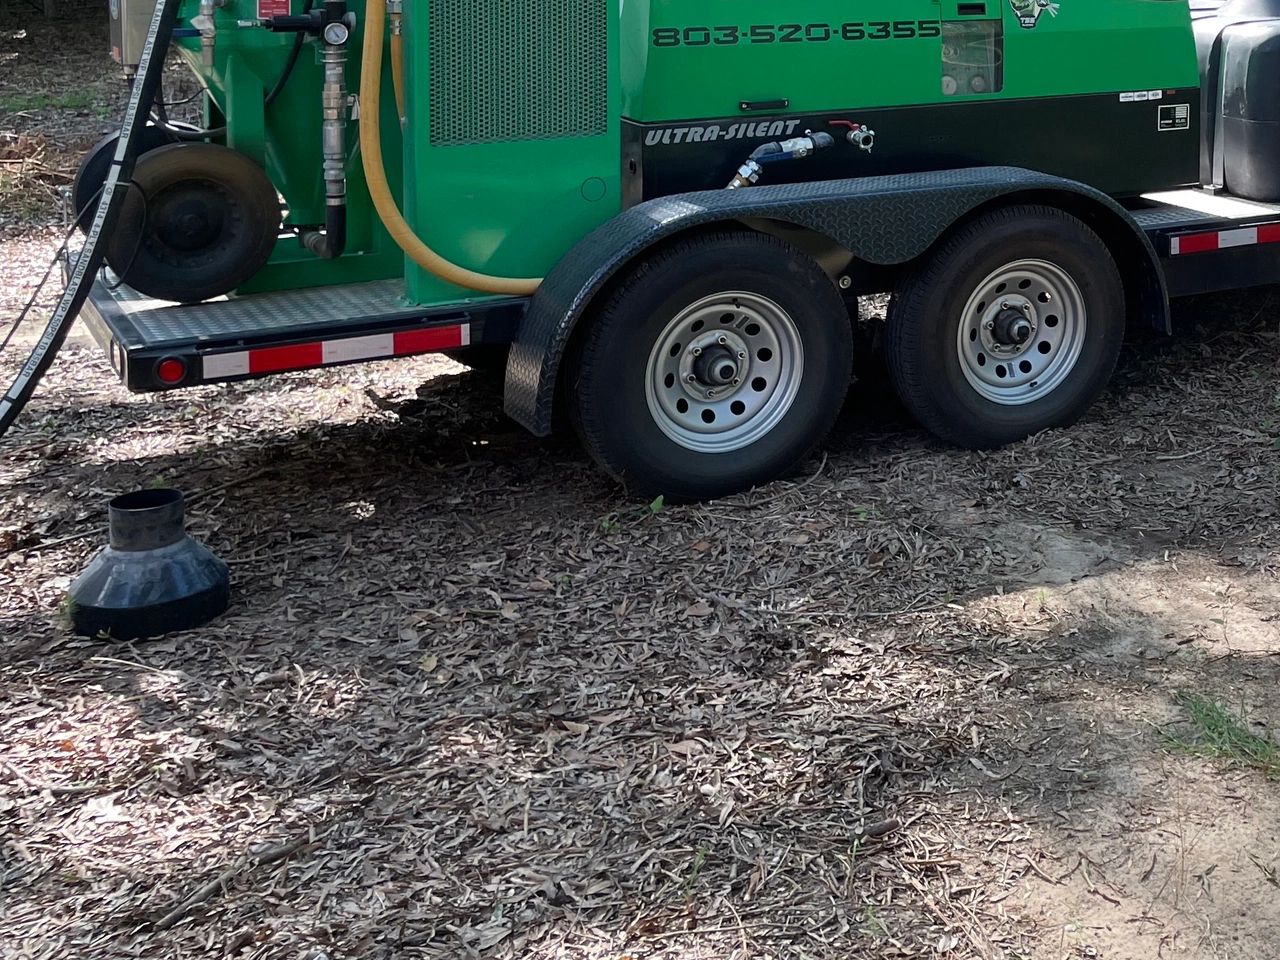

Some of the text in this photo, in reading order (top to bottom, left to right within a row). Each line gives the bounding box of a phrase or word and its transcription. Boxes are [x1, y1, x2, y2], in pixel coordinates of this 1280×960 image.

[644, 120, 800, 146] ULTRA-SILENT
[67, 248, 92, 297] SANDBLAST
[60, 299, 70, 312] WP
